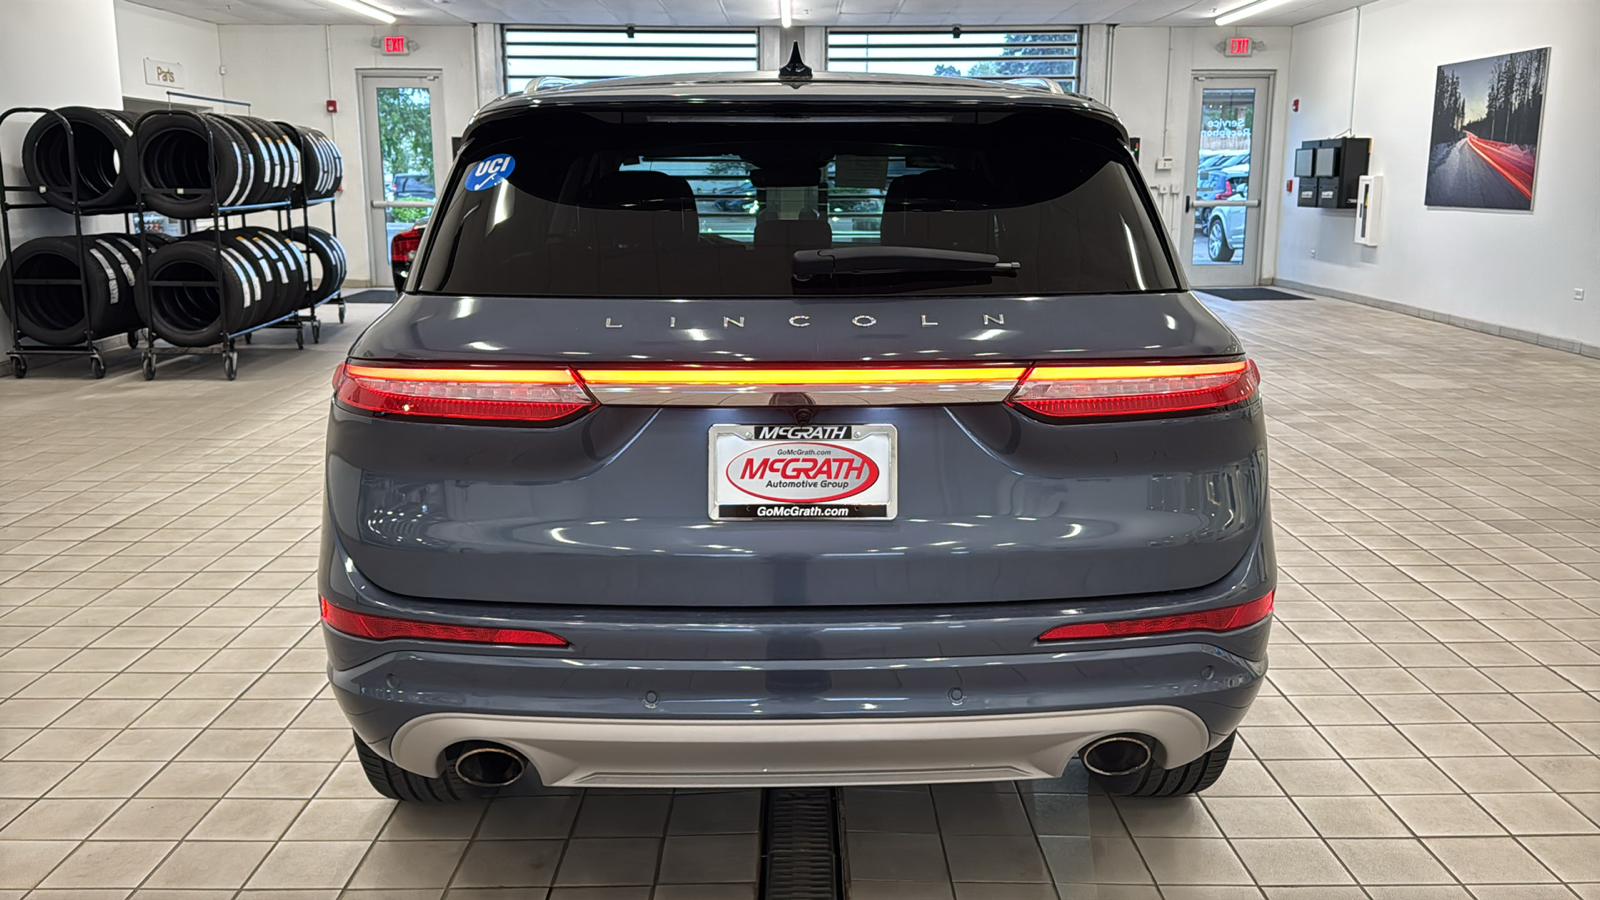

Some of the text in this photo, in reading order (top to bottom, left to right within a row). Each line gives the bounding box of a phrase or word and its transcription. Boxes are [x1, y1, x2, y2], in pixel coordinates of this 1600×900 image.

[385, 36, 404, 53] EXIT
[1230, 38, 1250, 54] EXIT
[157, 66, 175, 83] Parts
[474, 156, 512, 177] UCI
[605, 313, 1006, 329] LINCOLN
[765, 480, 849, 490] Automotive Group
[757, 506, 849, 517] GoMcGrath.com
